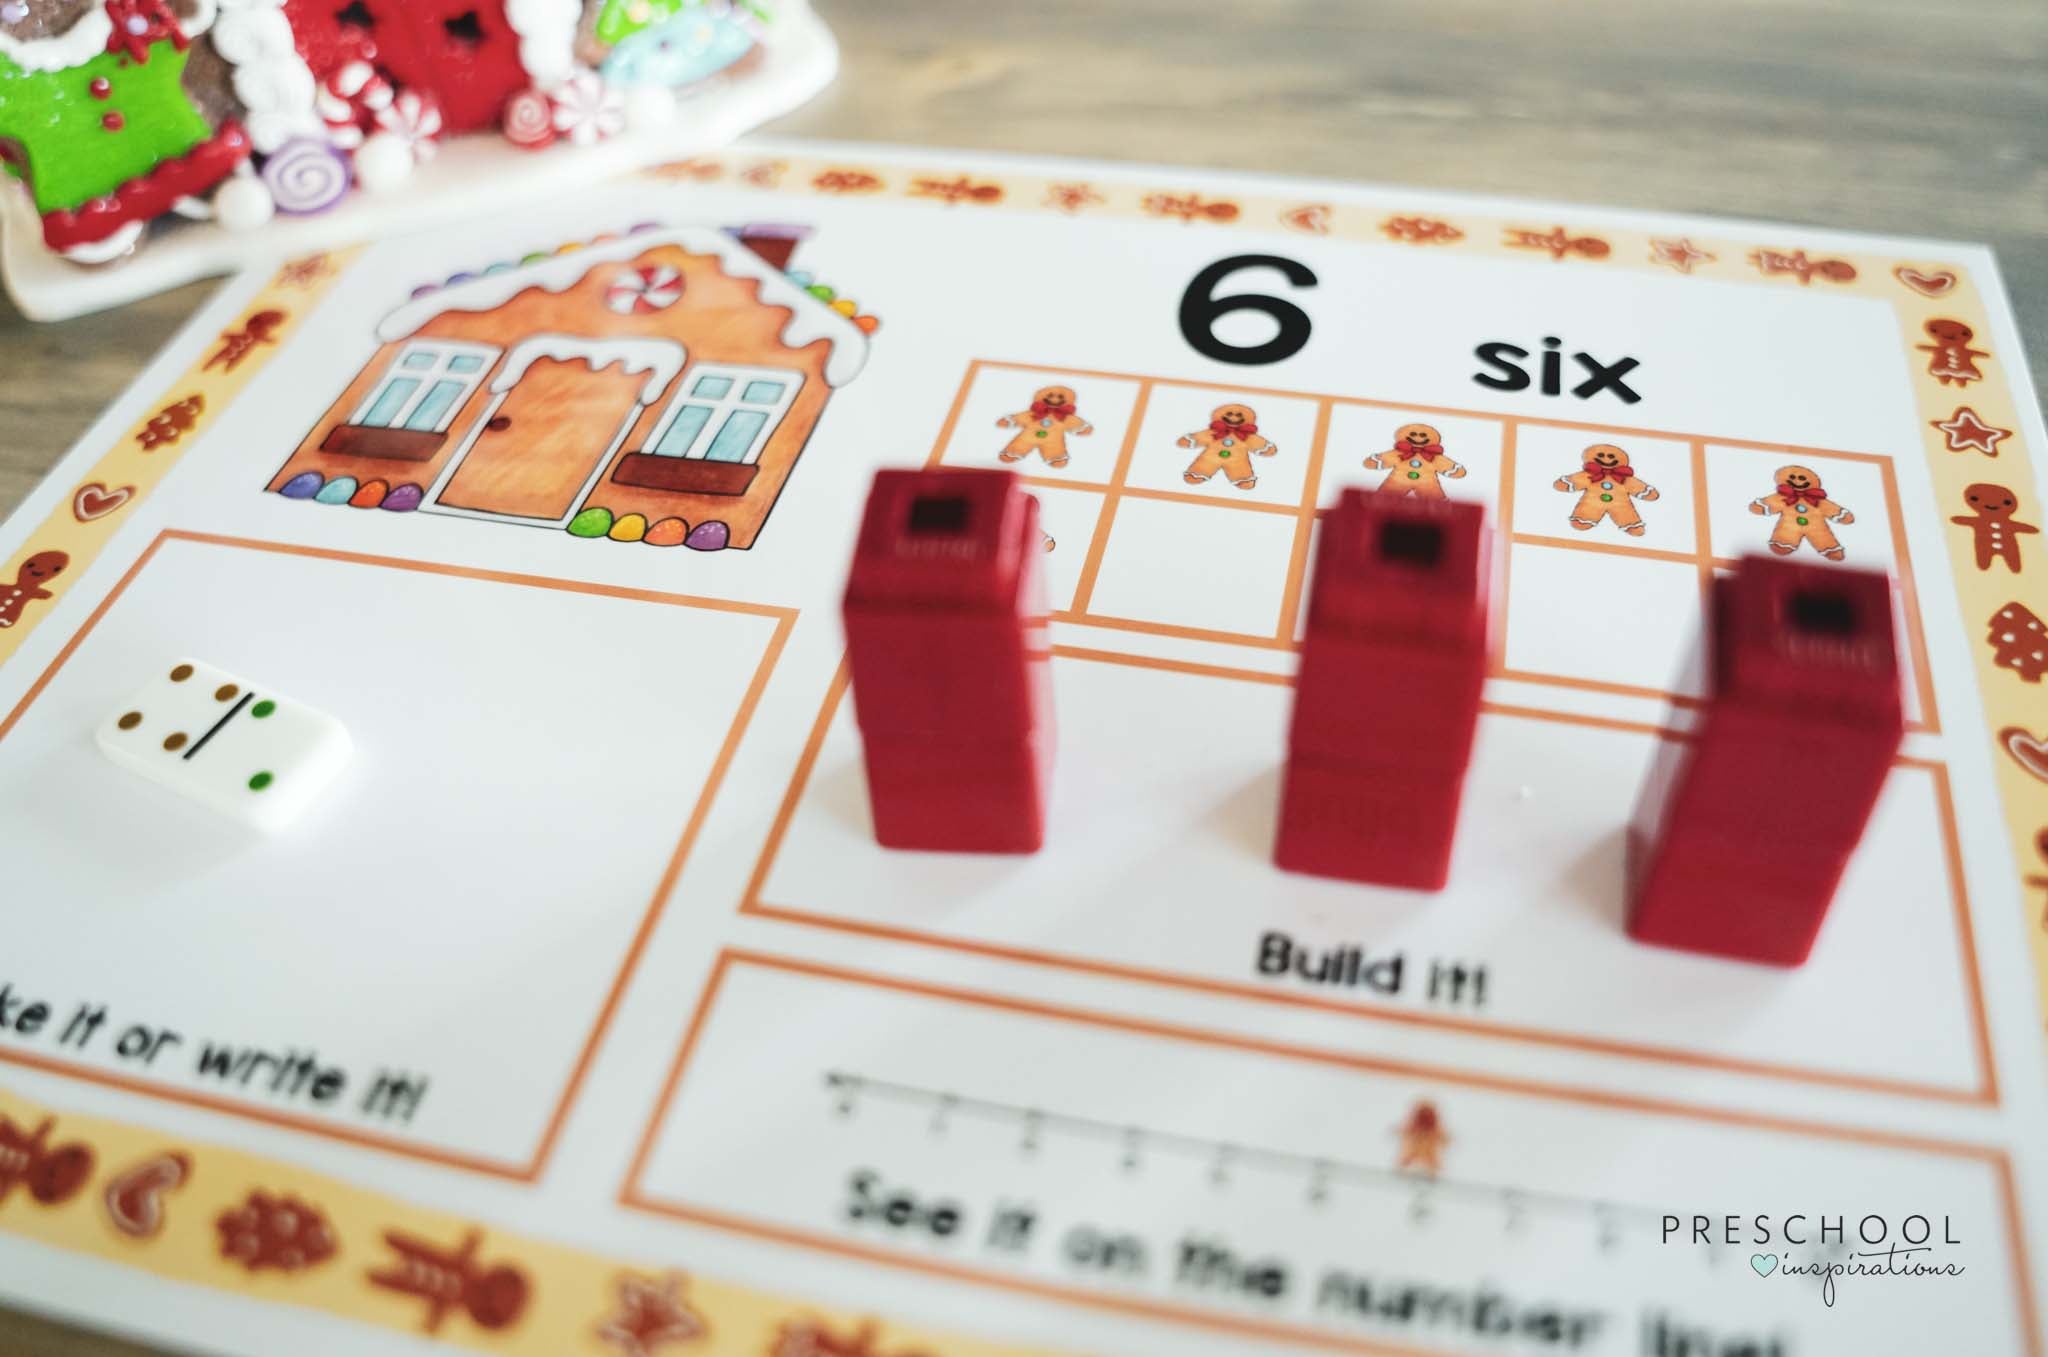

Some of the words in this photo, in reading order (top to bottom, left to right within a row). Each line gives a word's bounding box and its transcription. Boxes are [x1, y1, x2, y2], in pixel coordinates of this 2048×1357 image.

[1179, 254, 1318, 365] 6
[1473, 336, 1641, 403] six
[1257, 930, 1402, 994] Build
[1428, 959, 1488, 1006] it!
[59, 1004, 106, 1045] it
[117, 1026, 181, 1063] or
[199, 1040, 346, 1100] write
[362, 1070, 427, 1121] it!
[848, 1170, 958, 1238] See
[1063, 1226, 1144, 1270] on
[1177, 1236, 1287, 1301] the
[1318, 1268, 1606, 1346] number
